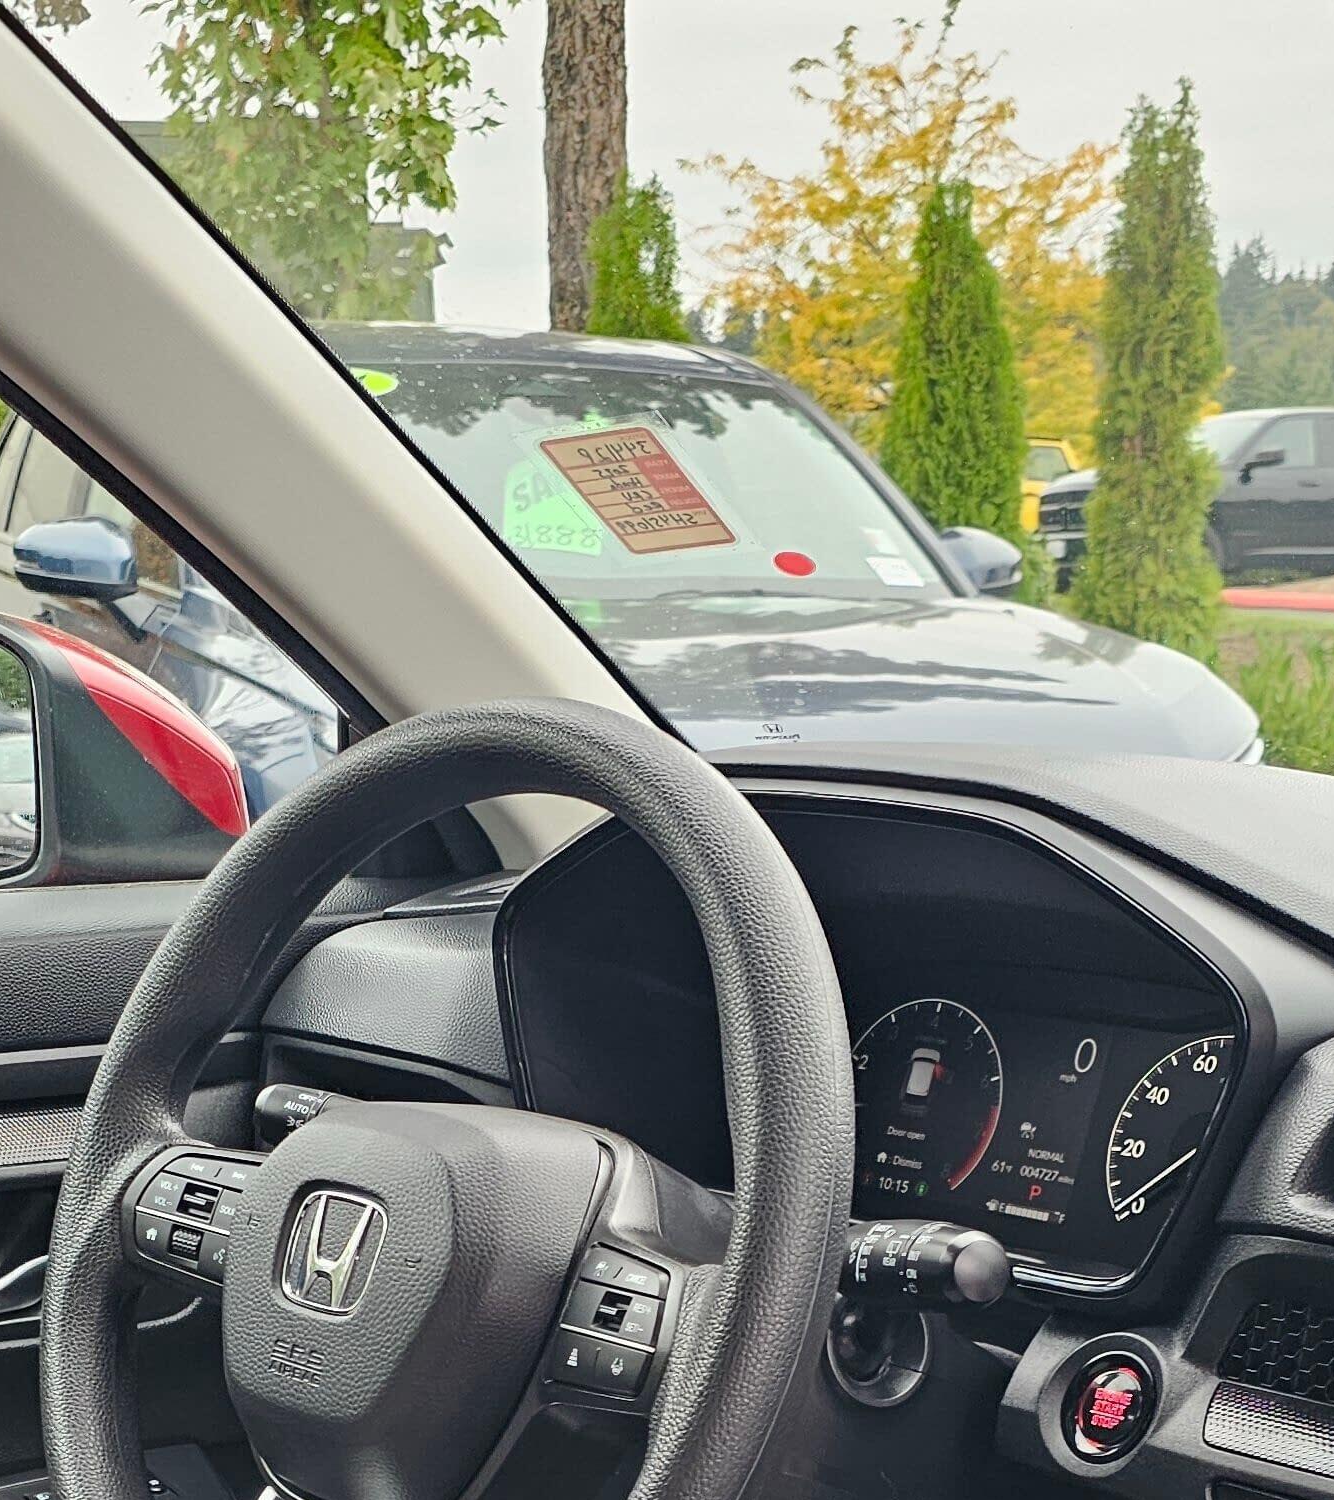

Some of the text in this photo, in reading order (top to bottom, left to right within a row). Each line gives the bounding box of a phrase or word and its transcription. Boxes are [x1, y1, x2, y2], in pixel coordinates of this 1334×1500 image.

[857, 1054, 869, 1070] 2
[1074, 1038, 1098, 1073] 0
[1192, 1054, 1218, 1074] 60
[1059, 1073, 1077, 1084] mph
[1145, 1086, 1170, 1106] 40
[283, 1101, 309, 1115] AUTO
[887, 1126, 906, 1137] Door
[1028, 1148, 1065, 1163] NORMAL
[1119, 1138, 1146, 1159] 20
[1020, 1165, 1059, 1181] 004727
[879, 1177, 909, 1193] 10:15
[1029, 1185, 1042, 1200] P
[219, 1204, 235, 1216] SOU
[1130, 1196, 1146, 1214] 0
[271, 1338, 325, 1367] SRS
[268, 1359, 321, 1388] AIRBAG
[1094, 1387, 1133, 1405] ENGINE
[1092, 1399, 1127, 1415] START
[1091, 1414, 1119, 1429] STOP
